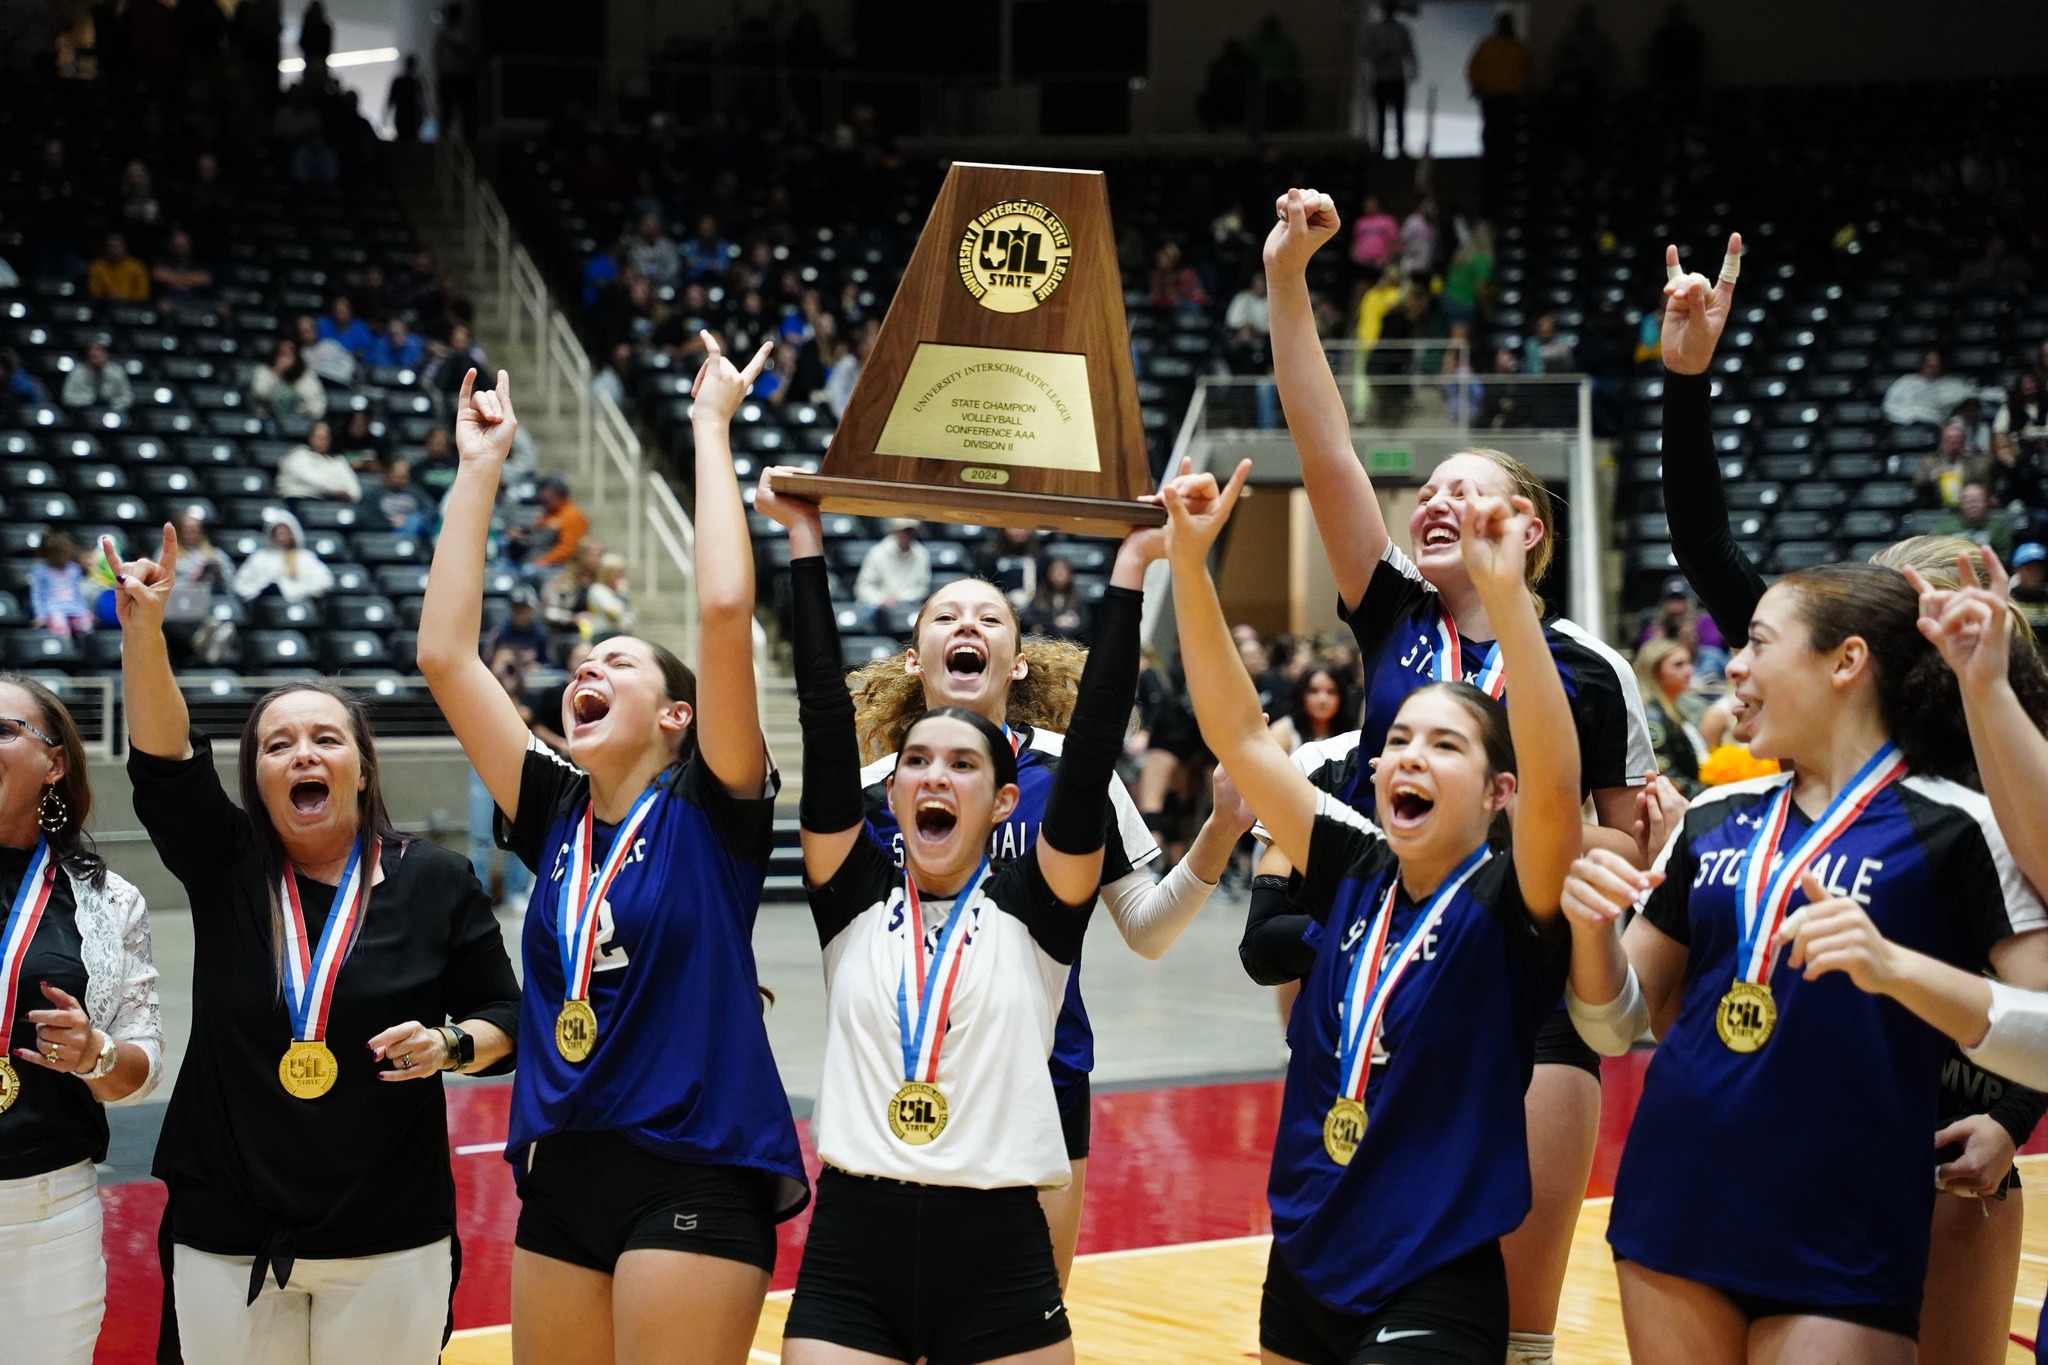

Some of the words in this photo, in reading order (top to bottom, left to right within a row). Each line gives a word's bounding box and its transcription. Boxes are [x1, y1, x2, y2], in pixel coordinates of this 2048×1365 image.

[959, 230, 986, 299] UNIVERSITY
[978, 202, 1069, 249] INTERSCHOLASTIC
[1034, 257, 1069, 302] LEAGUE
[979, 225, 1048, 274] UIL
[988, 273, 1033, 288] STATE
[913, 370, 962, 413] UNIVERSITY
[964, 362, 1048, 393] INTERSCHOLASTIC
[1045, 388, 1073, 424] LEAGUE
[951, 398, 980, 409] STATE
[982, 401, 1036, 413] CHAMPION
[961, 412, 1023, 426] VOLLEYBALL
[945, 424, 1012, 438] CONFERENCE
[1014, 430, 1036, 440] AAA
[963, 439, 1006, 451] DIVISION
[1008, 442, 1014, 451] II
[971, 470, 998, 481] 2024
[899, 1098, 936, 1123] UIL
[905, 1124, 928, 1132] STATE
